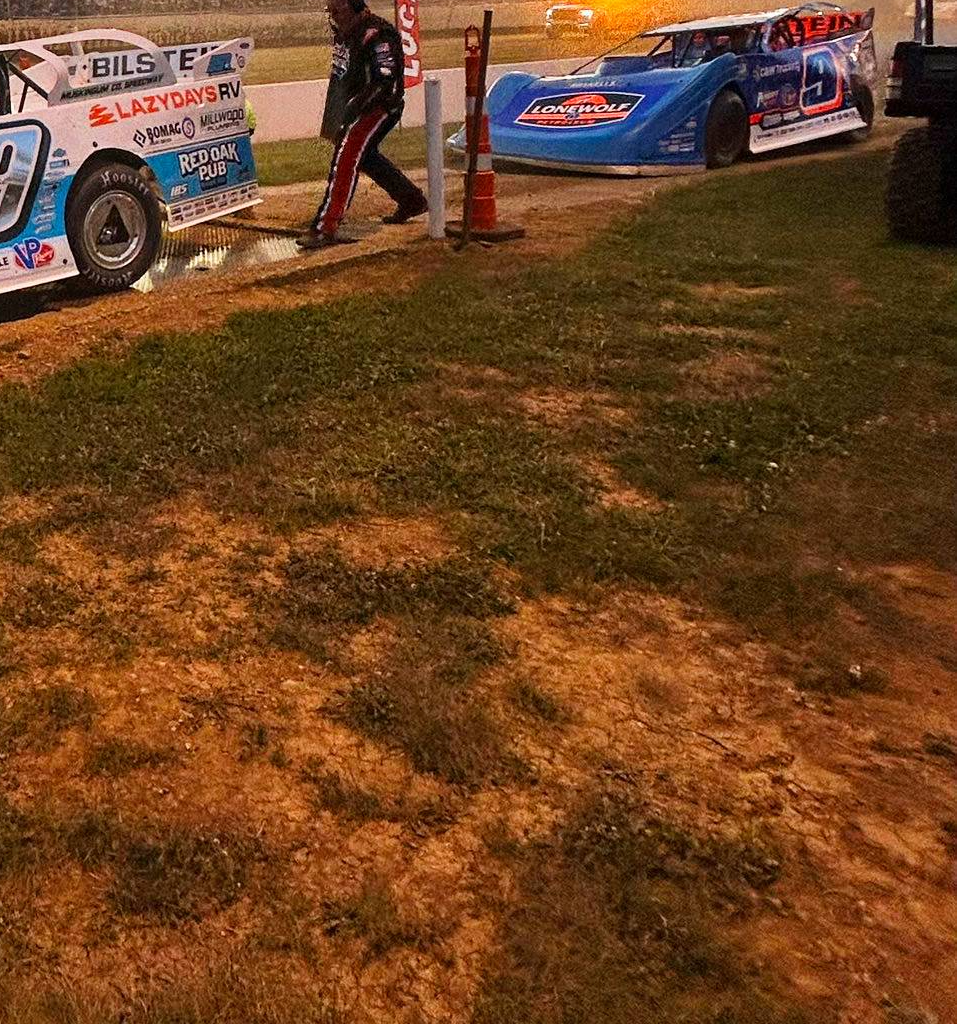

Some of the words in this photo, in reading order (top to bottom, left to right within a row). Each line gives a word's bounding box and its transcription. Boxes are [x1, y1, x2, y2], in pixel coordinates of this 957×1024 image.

[93, 45, 221, 78] BILSTE
[115, 85, 218, 119] LAZYDAYS
[218, 80, 241, 101] RV
[531, 102, 632, 114] LONEWOLF
[200, 108, 245, 127] MILLWOOD
[146, 122, 182, 140] BOMAG
[178, 149, 209, 175] RED
[210, 143, 241, 163] OAK
[198, 161, 227, 181] PUB
[13, 238, 41, 270] VP
